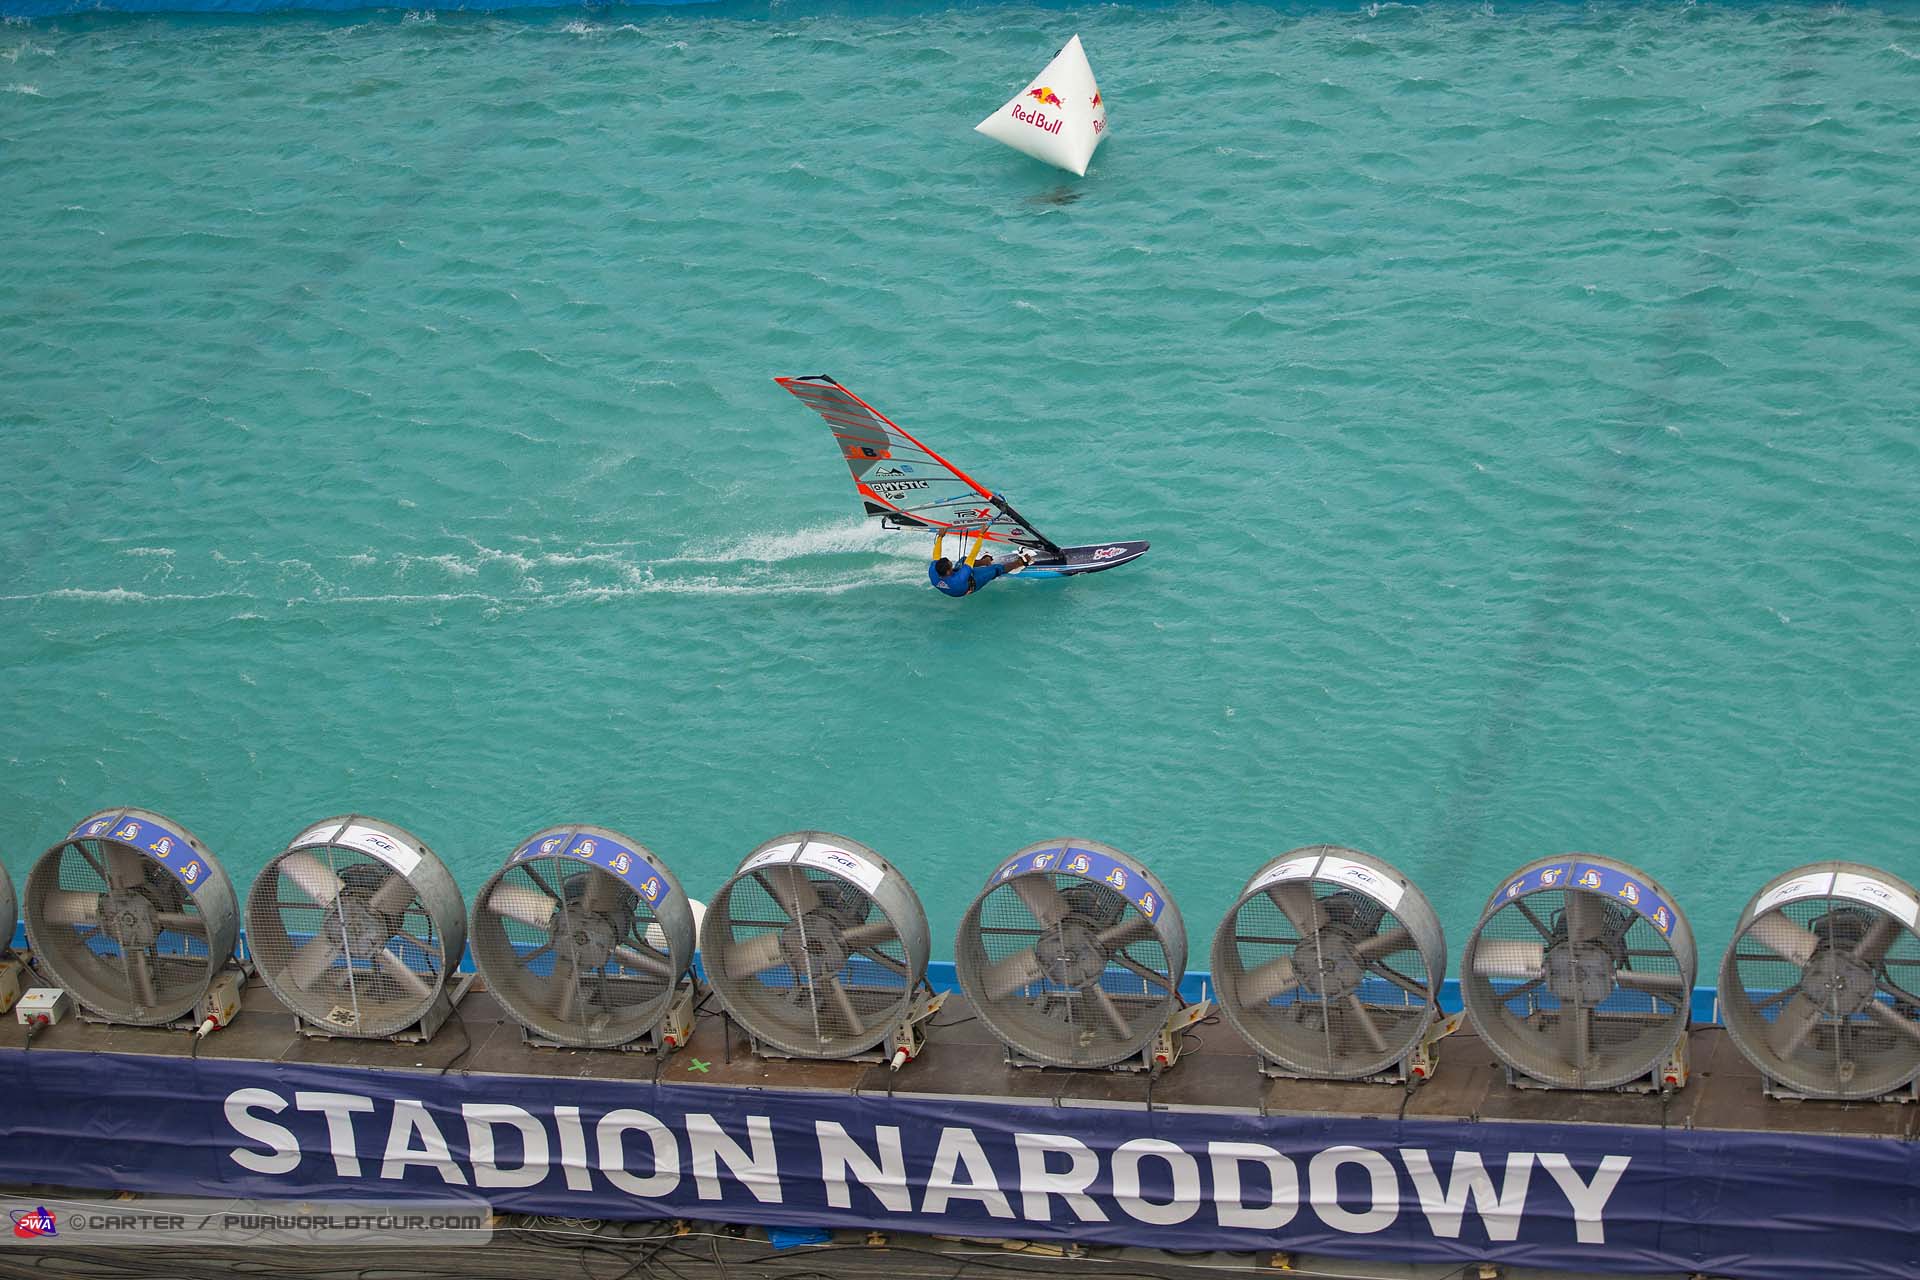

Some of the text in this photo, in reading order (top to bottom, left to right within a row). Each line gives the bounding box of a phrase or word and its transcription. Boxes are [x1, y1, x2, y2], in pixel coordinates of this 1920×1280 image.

[1012, 104, 1063, 135] Red Bull
[882, 481, 928, 492] MYSTIC
[366, 837, 395, 852] PGE
[827, 854, 857, 869] PGE
[223, 1087, 1632, 1244] STADION NARODOWY
